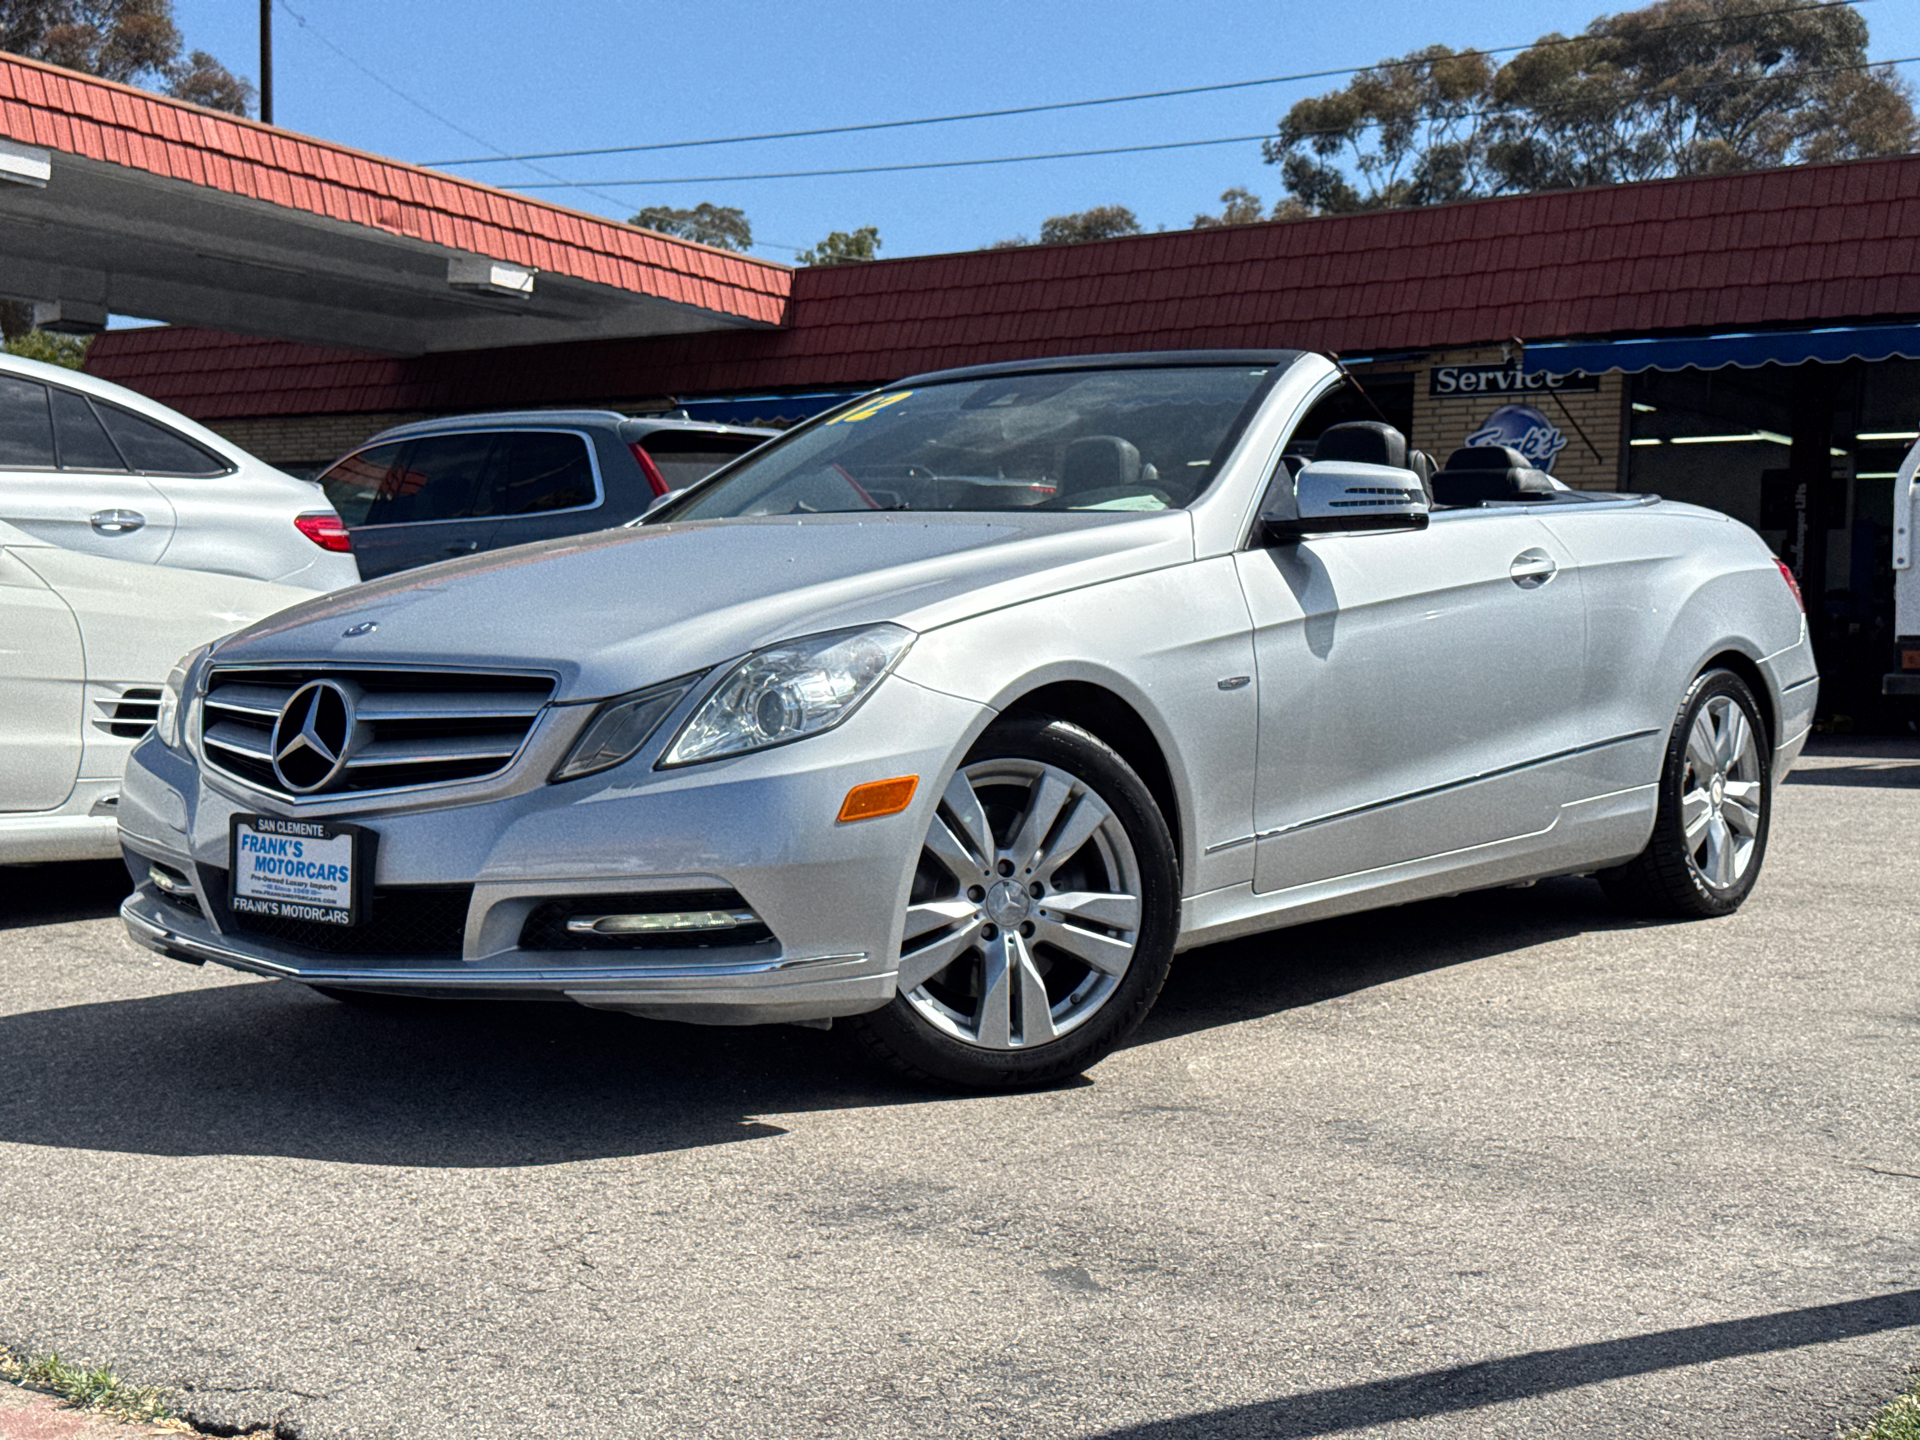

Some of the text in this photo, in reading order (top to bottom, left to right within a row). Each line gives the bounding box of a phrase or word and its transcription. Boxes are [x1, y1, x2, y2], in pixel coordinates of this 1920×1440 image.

[1437, 364, 1564, 393] Service
[1795, 483, 1807, 509] Lifts
[258, 818, 324, 837] SAN CLEMENTE
[241, 834, 304, 858] FRANK'S
[254, 856, 349, 883] MOTORCARS
[251, 874, 338, 892] Pre-Owned Luxury Imports
[274, 885, 292, 893] Since
[233, 897, 350, 924] FRANK'S MOTORCARS
